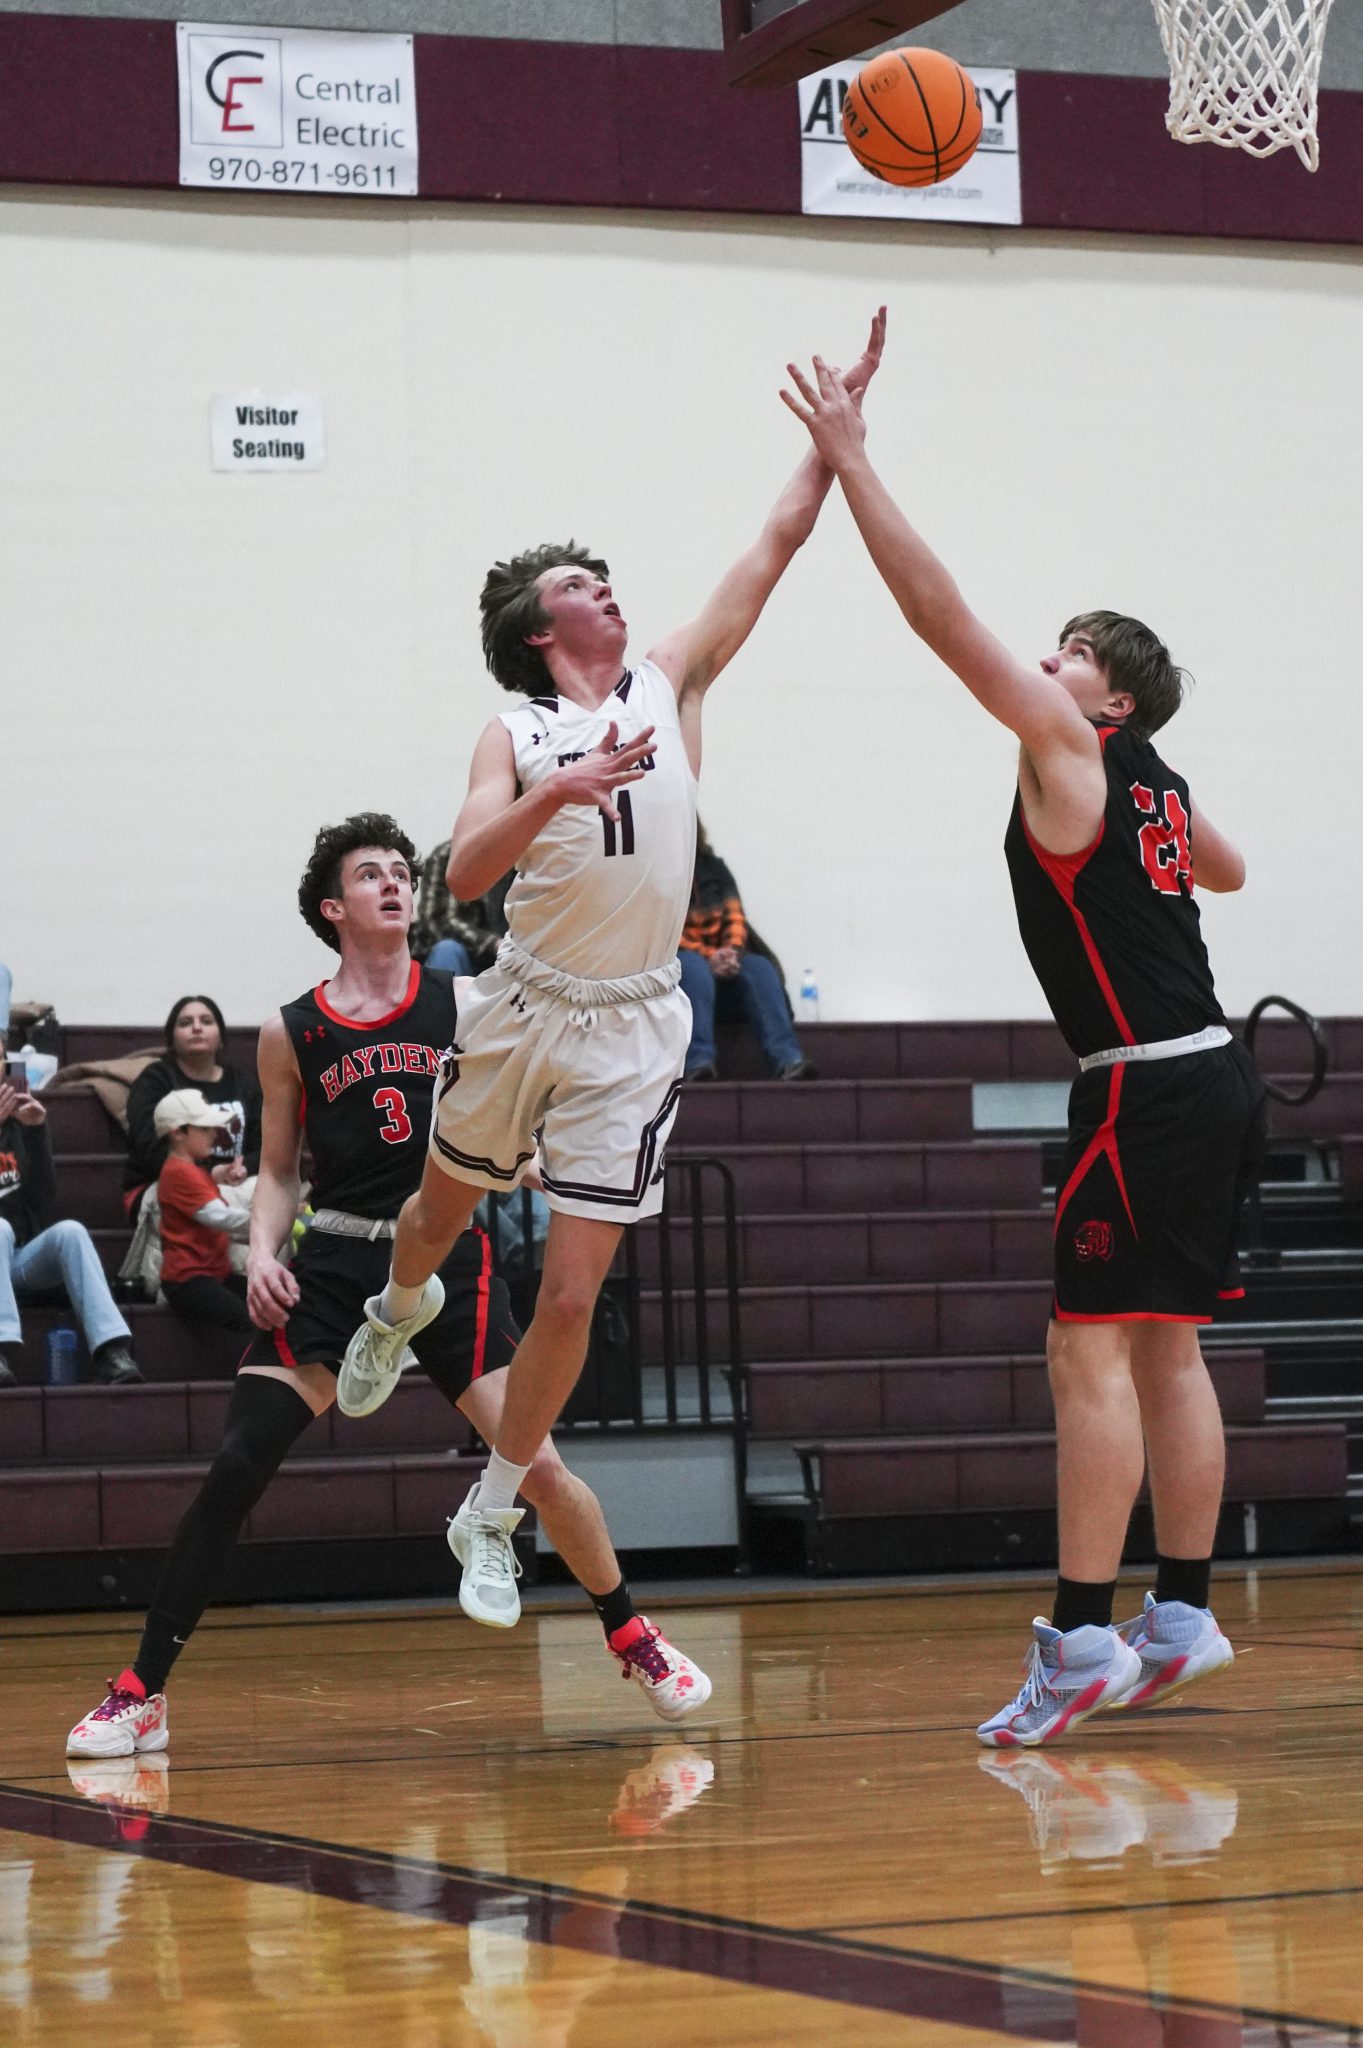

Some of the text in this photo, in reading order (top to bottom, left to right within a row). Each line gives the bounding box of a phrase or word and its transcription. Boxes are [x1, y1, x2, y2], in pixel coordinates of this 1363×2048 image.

[295, 73, 401, 104] Central
[296, 117, 406, 149] Electric
[208, 157, 396, 188] 970-871-9611
[235, 405, 299, 426] Visitor
[232, 438, 305, 461] Seating
[598, 789, 635, 857] 11
[319, 1042, 446, 1103] HAYDEN
[372, 1086, 413, 1145] 3
